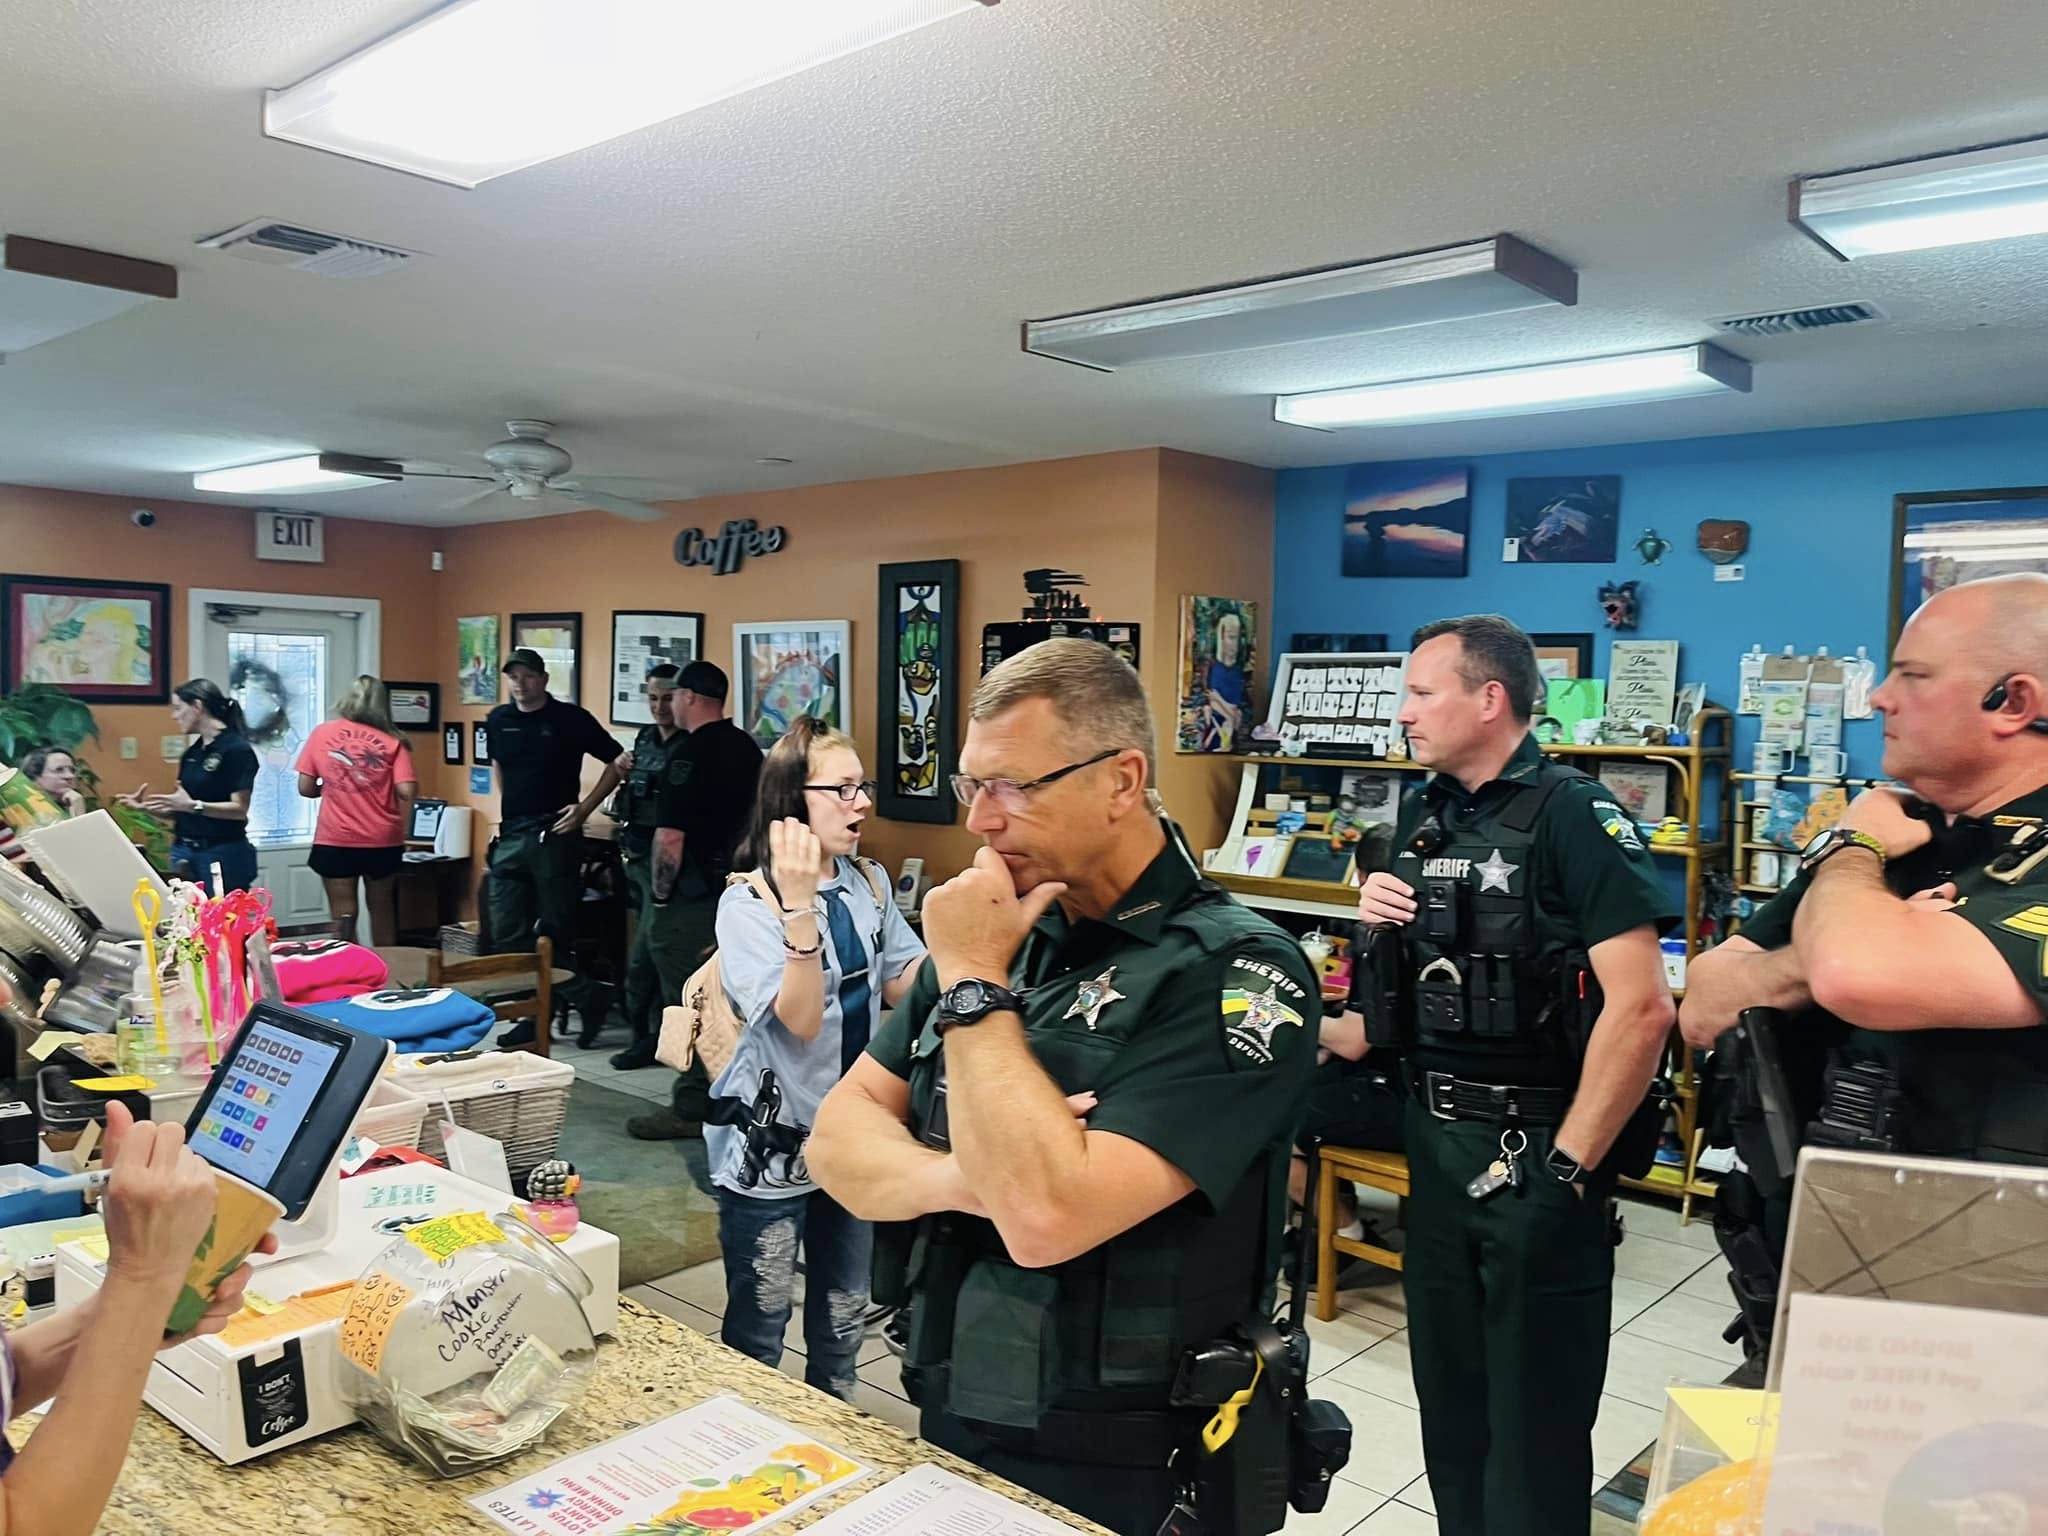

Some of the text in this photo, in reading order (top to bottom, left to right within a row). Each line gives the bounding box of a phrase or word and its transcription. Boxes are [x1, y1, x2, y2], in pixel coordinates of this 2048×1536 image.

[272, 515, 314, 547] EXIT
[674, 518, 787, 576] Coffee
[1422, 858, 1471, 878] SHERIFF
[1231, 958, 1306, 998] SHERIFF
[1228, 1037, 1267, 1064] DEPUTY
[261, 1415, 296, 1435] Coffee
[557, 1477, 591, 1498] MENU
[487, 1500, 539, 1531] LATTES
[560, 1506, 599, 1529] PLANT
[565, 1496, 611, 1523] ENERGY
[589, 1494, 624, 1517] DRINK
[548, 1511, 587, 1535] LOTUS
